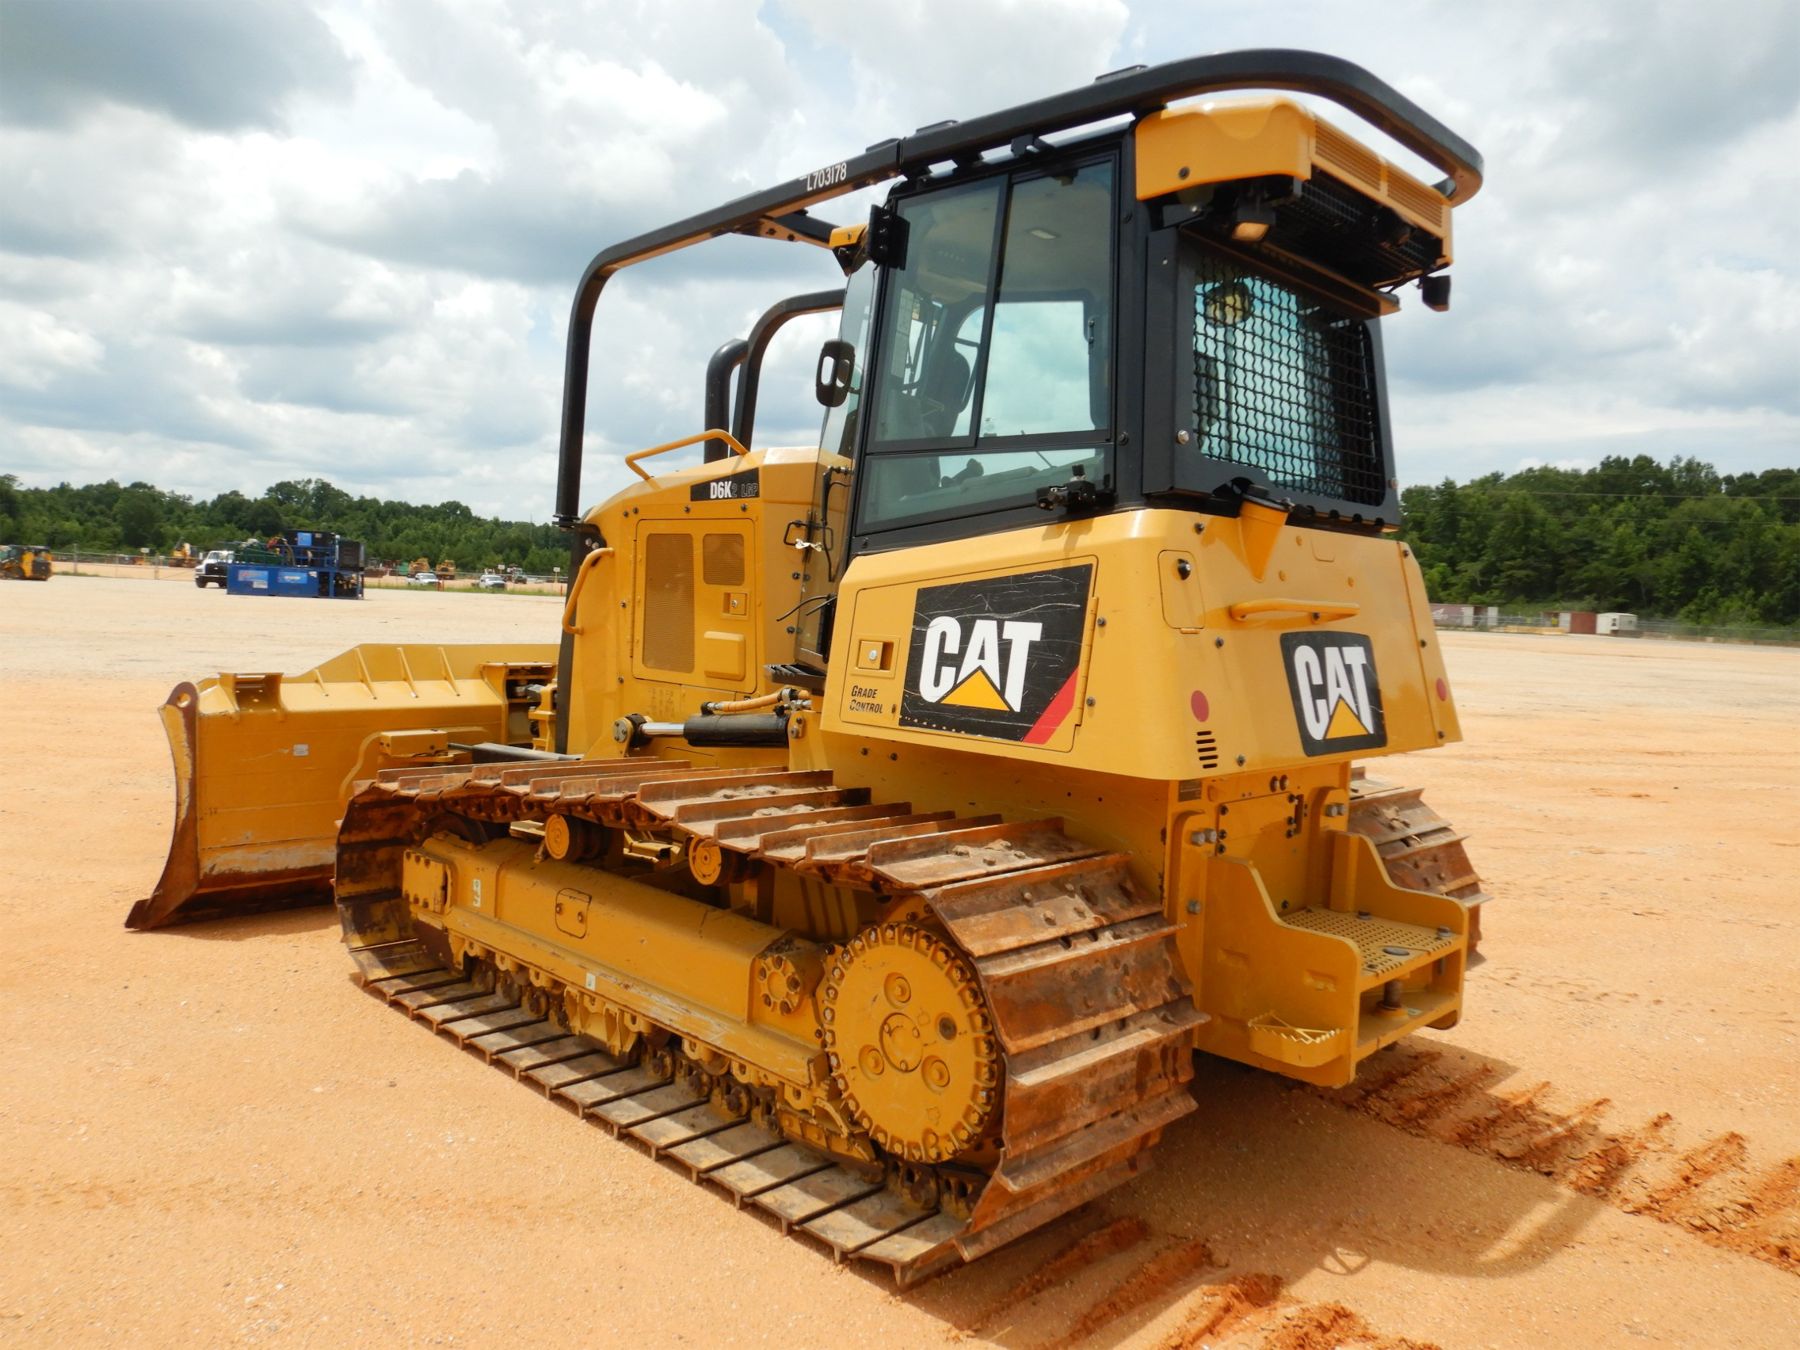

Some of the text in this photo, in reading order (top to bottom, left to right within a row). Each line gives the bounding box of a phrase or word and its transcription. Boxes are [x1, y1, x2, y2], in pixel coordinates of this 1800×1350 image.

[806, 162, 847, 191] L703178
[919, 616, 1043, 713] CAT
[849, 699, 884, 714] CONTROL
[851, 685, 878, 699] GRADE
[1294, 645, 1375, 741] CAT
